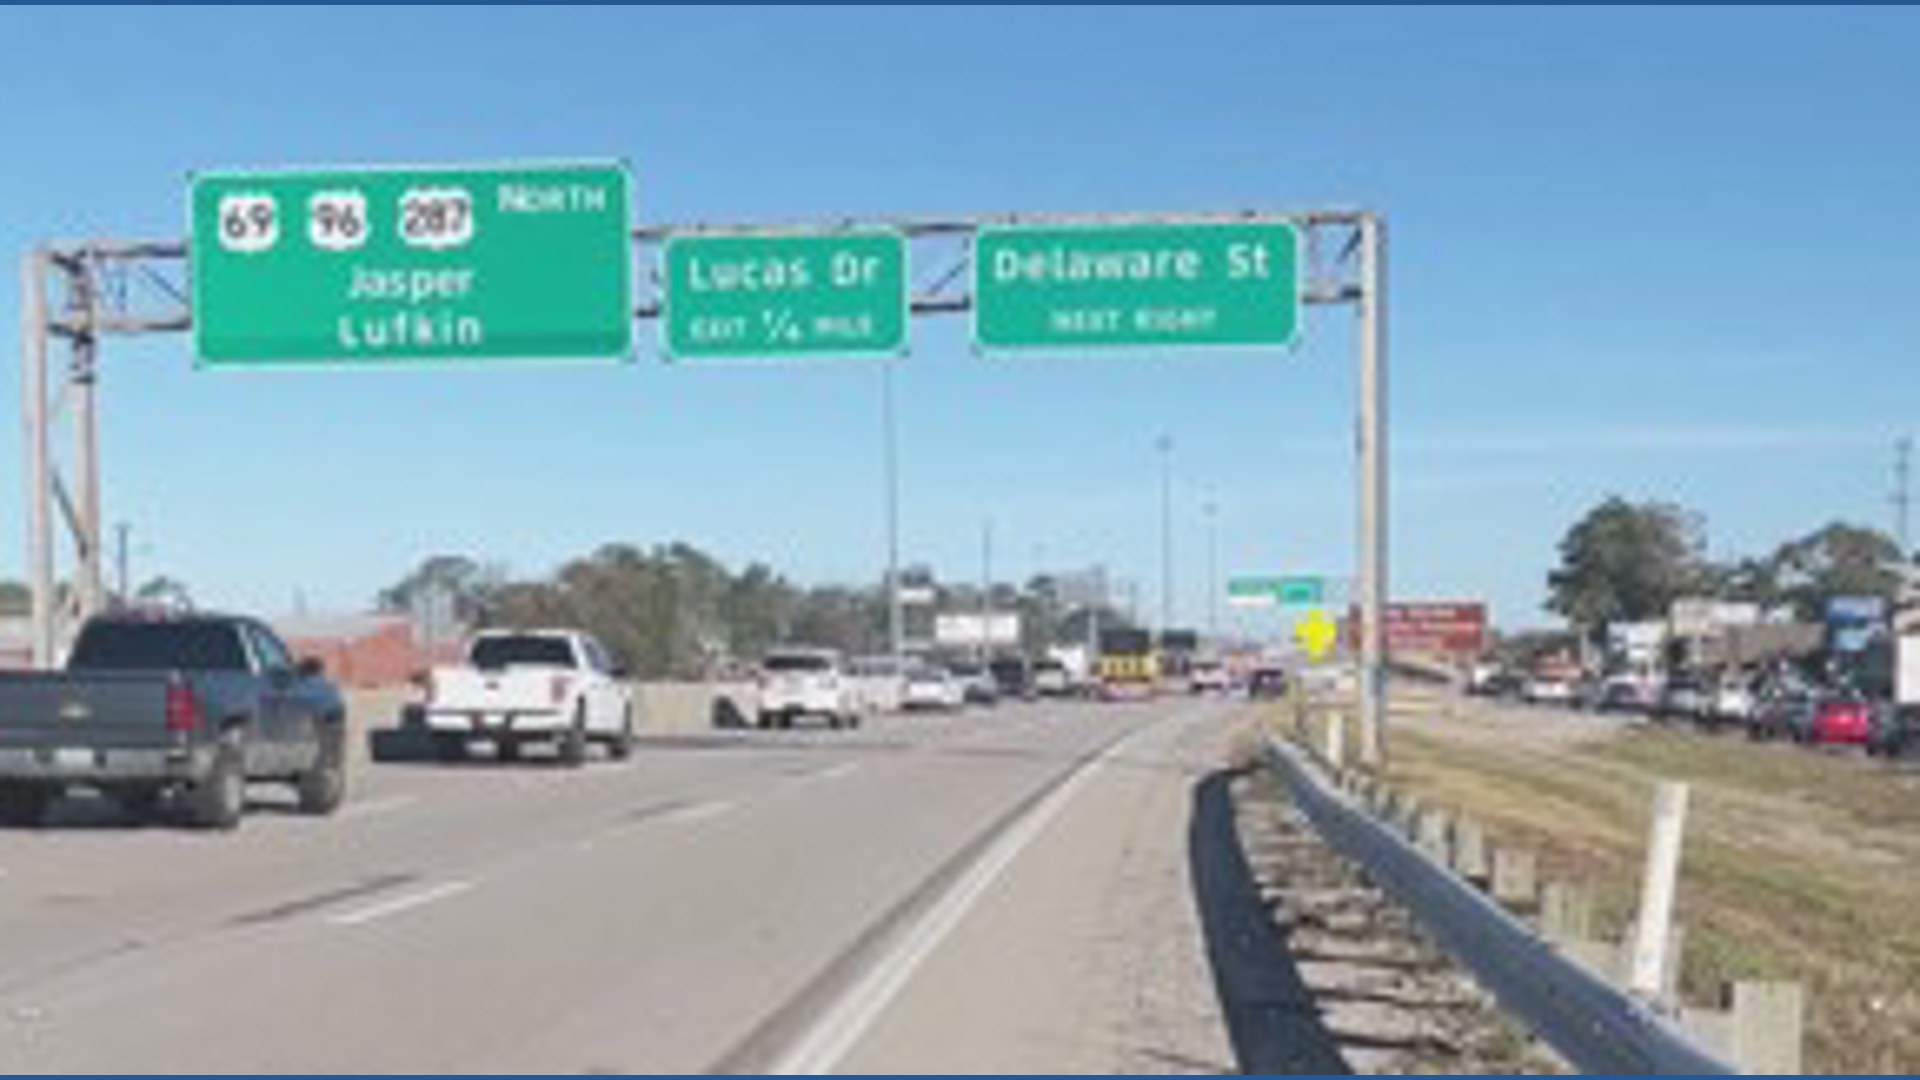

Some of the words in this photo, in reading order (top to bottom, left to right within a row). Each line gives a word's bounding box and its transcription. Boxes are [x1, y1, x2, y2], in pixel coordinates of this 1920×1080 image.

[403, 198, 468, 235] 287
[498, 184, 606, 212] NORTH
[223, 202, 274, 239] 69
[314, 202, 365, 239] 96
[689, 254, 811, 290] Lucas
[831, 250, 882, 286] Dr
[994, 245, 1199, 281] Delaware
[1227, 243, 1270, 279] St
[348, 265, 474, 302] Jasper
[338, 312, 484, 347] Lufkin
